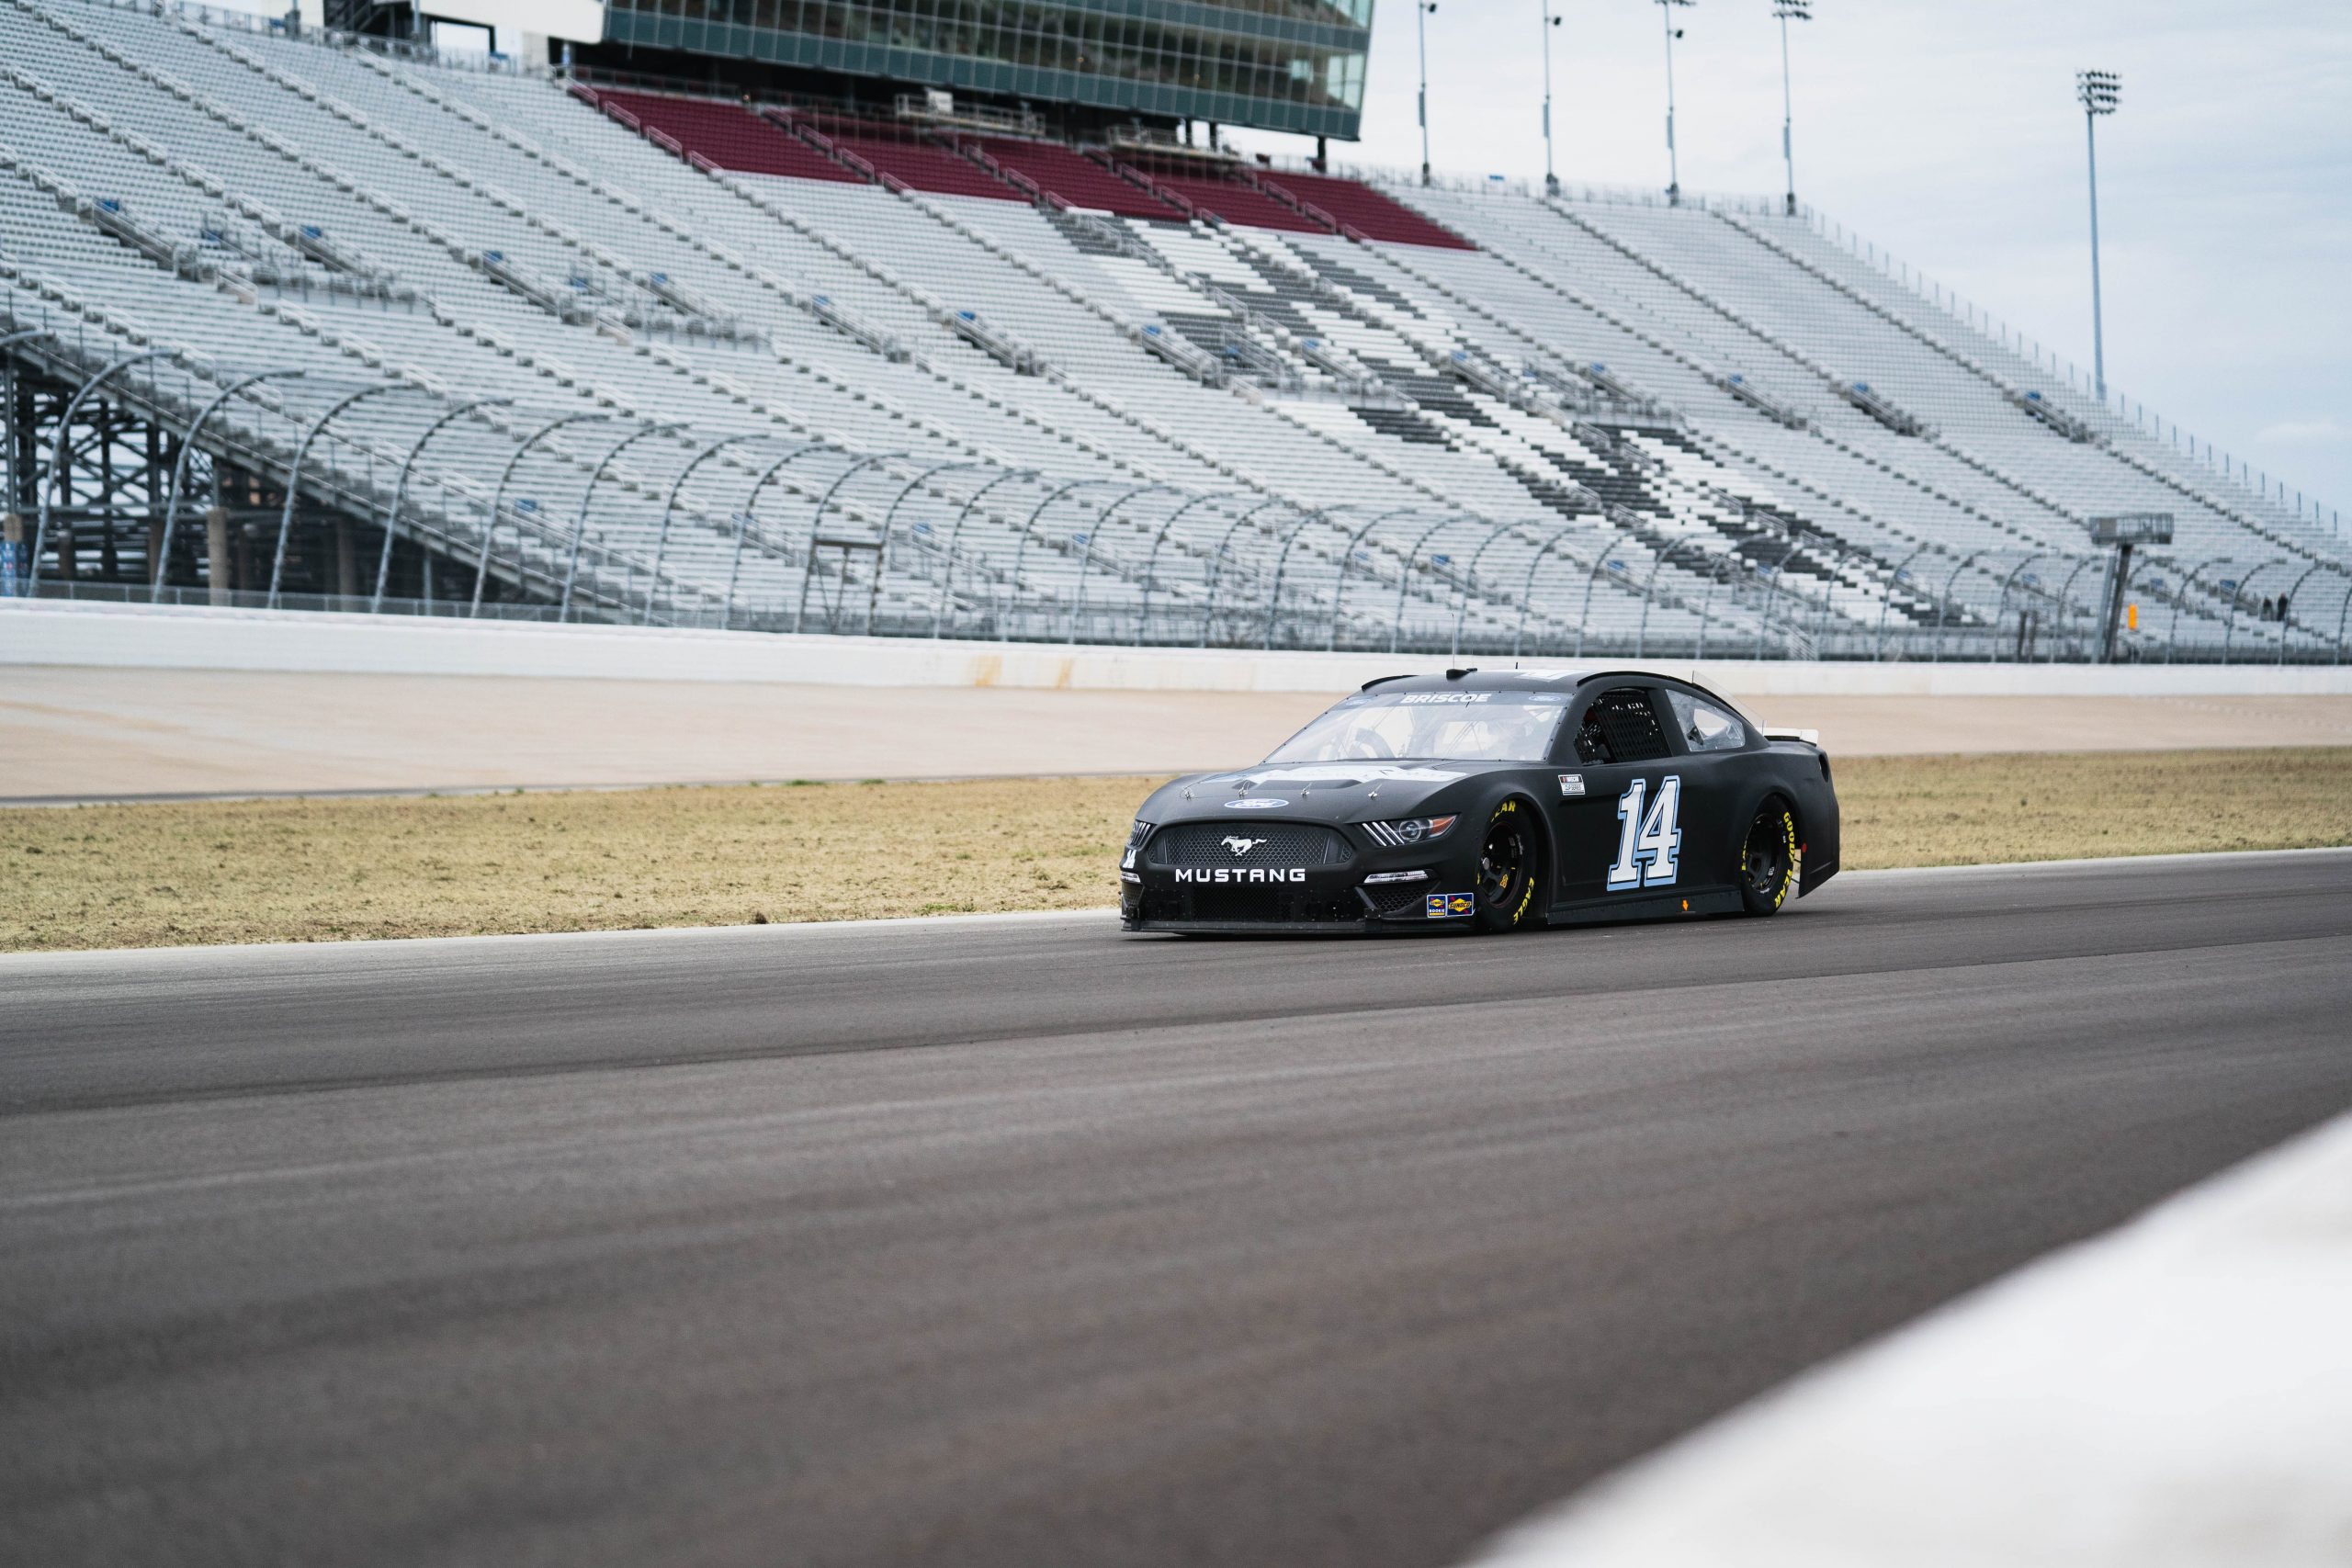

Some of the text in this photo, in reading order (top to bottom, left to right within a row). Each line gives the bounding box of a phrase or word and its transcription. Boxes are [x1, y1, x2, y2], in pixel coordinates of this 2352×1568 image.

[1400, 694, 1492, 704] BRISCOE
[1607, 775, 1682, 891] 14
[1175, 868, 1306, 883] MUSTANG
